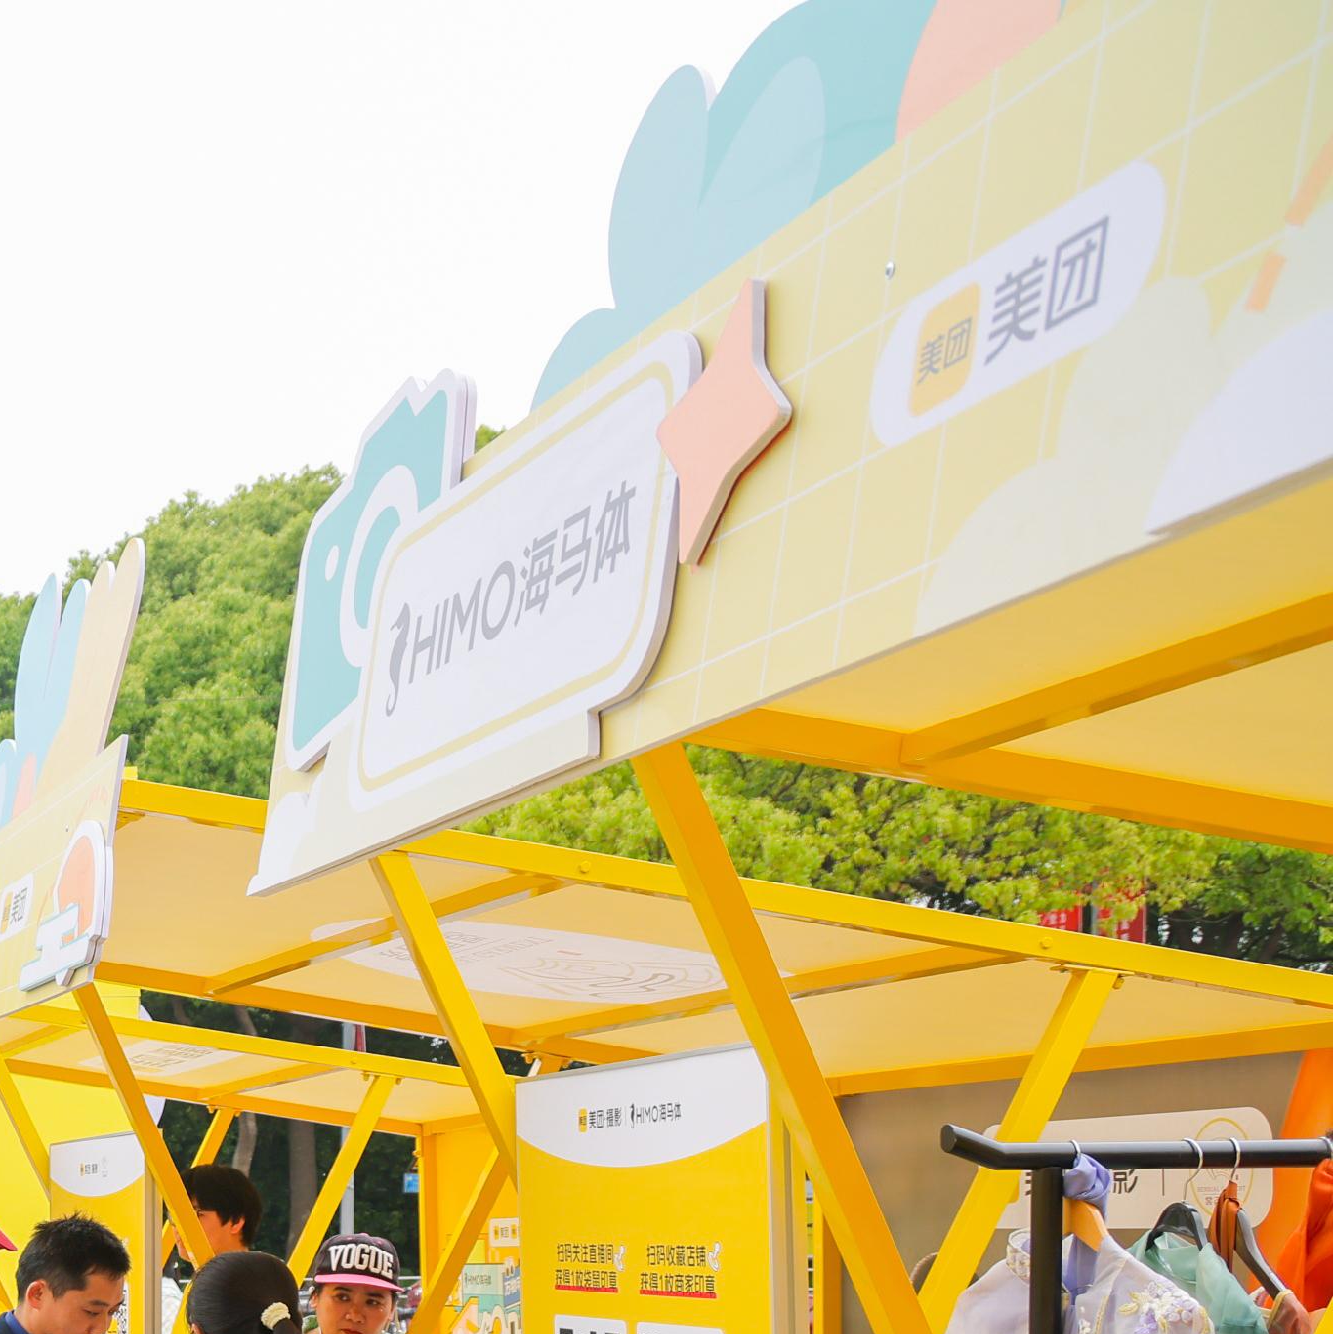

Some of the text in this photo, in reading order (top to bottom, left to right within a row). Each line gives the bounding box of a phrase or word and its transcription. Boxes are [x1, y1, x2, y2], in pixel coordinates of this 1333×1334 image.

[916, 215, 1109, 386] 美团 美团
[408, 479, 638, 685] HIMO海马体
[328, 1243, 394, 1280] VOGUE
